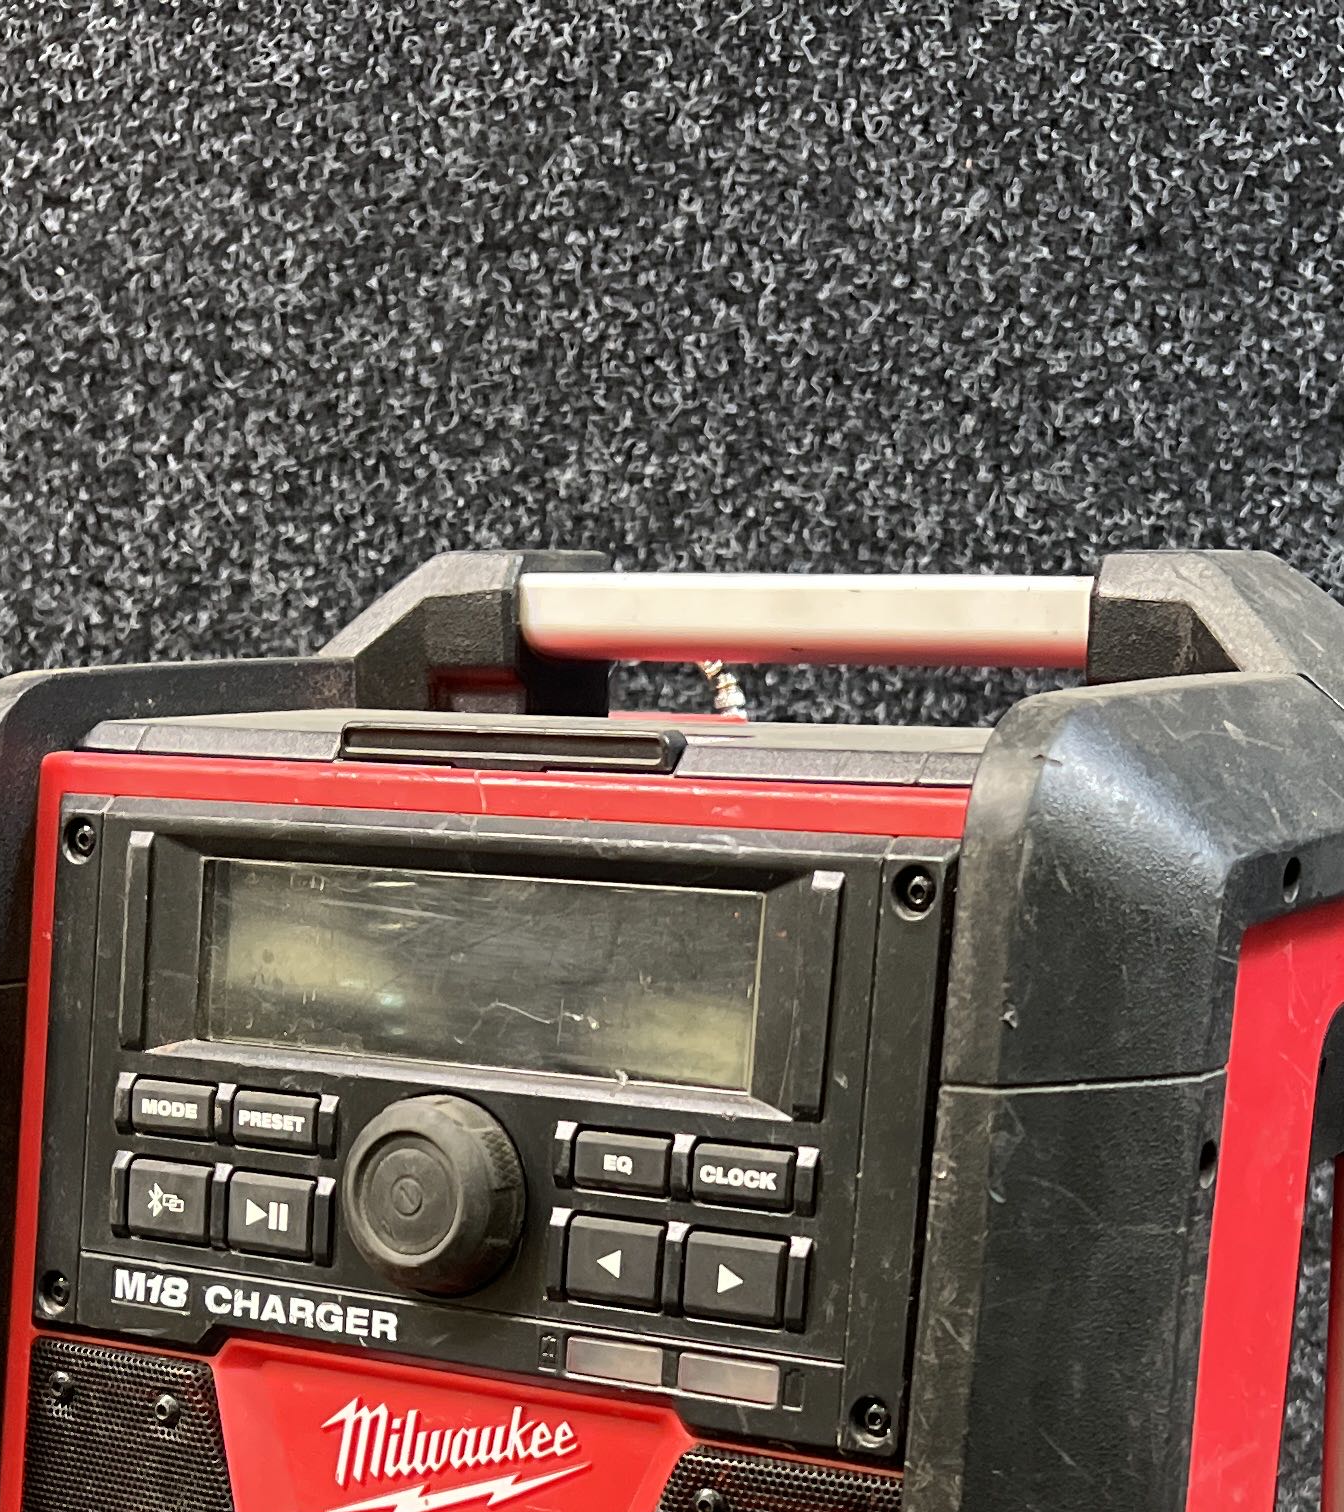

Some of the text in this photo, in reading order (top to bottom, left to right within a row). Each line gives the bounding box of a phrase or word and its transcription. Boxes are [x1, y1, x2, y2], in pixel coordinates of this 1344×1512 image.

[141, 1098, 198, 1120] MODE
[238, 1109, 307, 1133] PRESET
[602, 1154, 633, 1176] EQ
[699, 1165, 778, 1191] CLOCK
[113, 1268, 399, 1342] M18 CHARGER
[321, 1396, 581, 1487] Milwaukee
